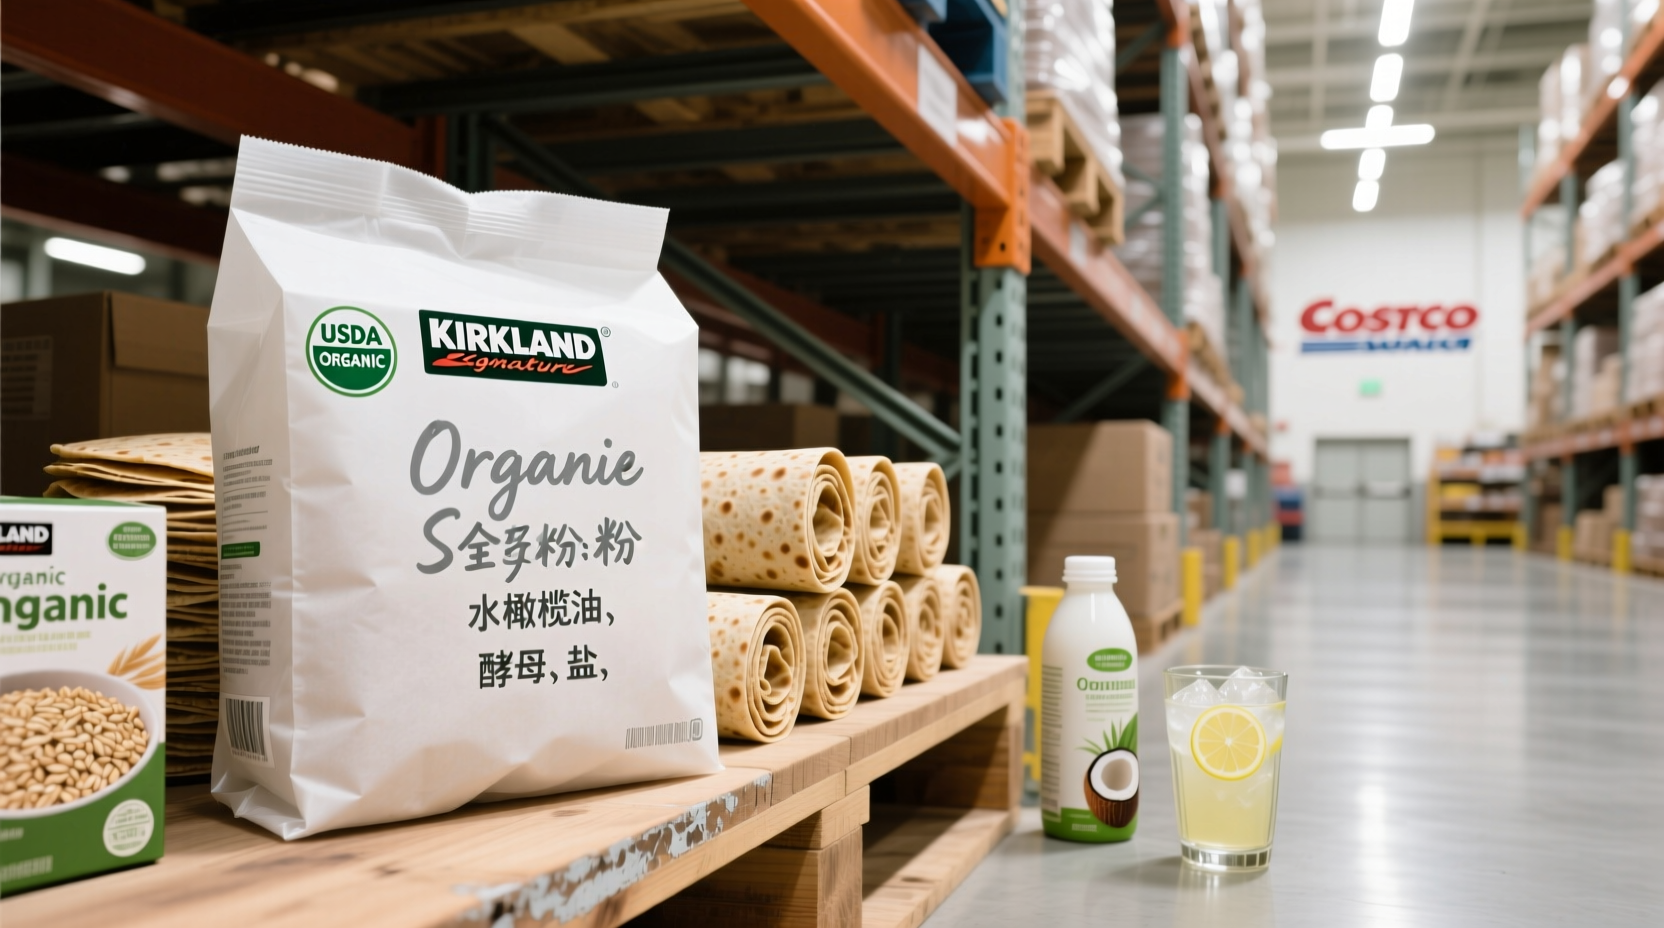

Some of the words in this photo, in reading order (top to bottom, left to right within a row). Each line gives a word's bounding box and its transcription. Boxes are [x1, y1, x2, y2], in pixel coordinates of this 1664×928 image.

[320, 323, 383, 346] USDA
[429, 317, 596, 360] KIRKLAND
[319, 351, 386, 369] ORGANIC
